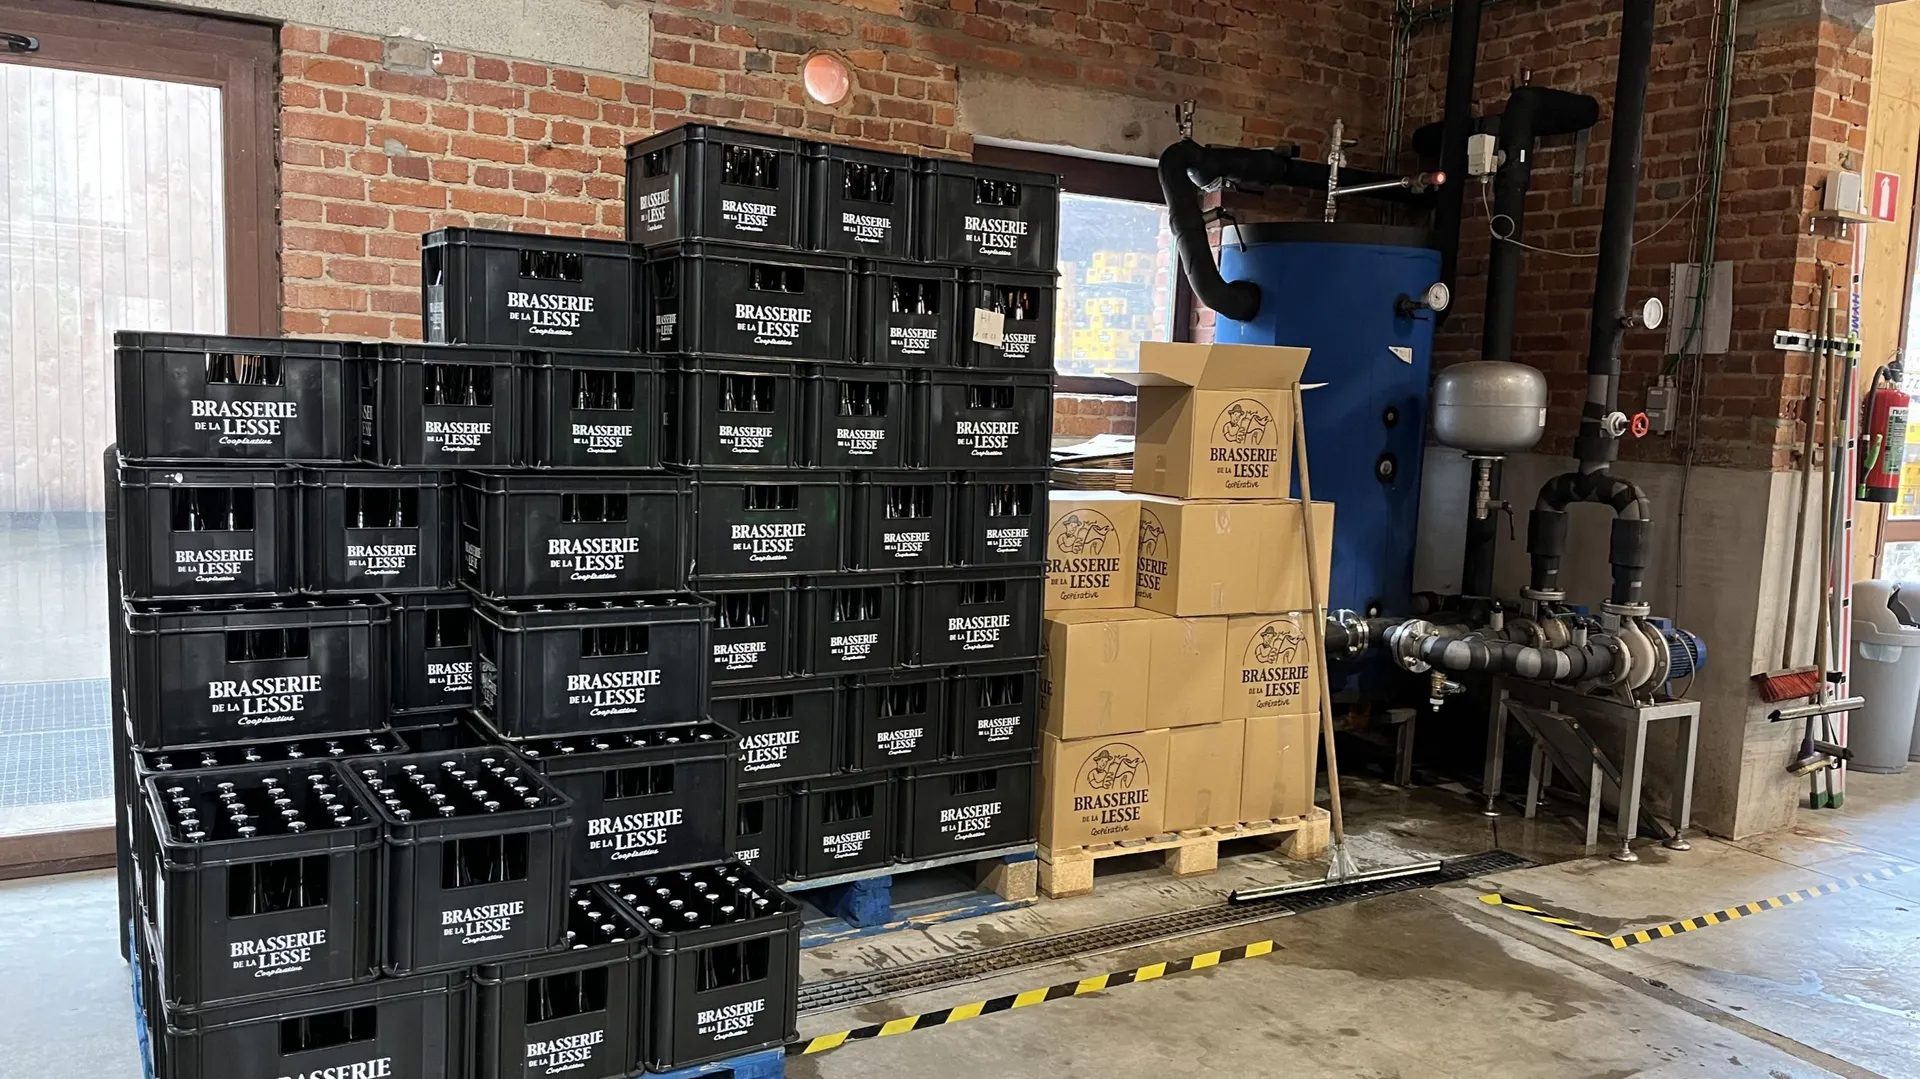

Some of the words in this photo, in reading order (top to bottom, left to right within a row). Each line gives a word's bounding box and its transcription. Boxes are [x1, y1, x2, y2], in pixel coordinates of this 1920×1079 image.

[722, 200, 776, 216] BRASSERIE
[738, 213, 768, 226] LESSE
[843, 213, 891, 228] BRASSERIE
[965, 216, 1027, 235] BRASSERIE
[856, 225, 884, 238] LESSE
[982, 233, 1017, 248] LESSE
[507, 292, 594, 312] BRASSERIE
[510, 312, 519, 320] DE
[533, 310, 580, 327] LESSE
[735, 304, 811, 323] BRASSERIE
[757, 321, 799, 338] LESSE
[890, 327, 937, 339] BRASSERIE
[904, 338, 929, 349] LESSE
[1002, 333, 1036, 343] ASSERIE
[1005, 343, 1030, 353] LESSE
[191, 400, 297, 418] BRASSERIE
[195, 422, 207, 430] DE
[209, 422, 221, 430] LA
[223, 419, 281, 435] LESSE
[425, 421, 491, 434] BRASSERIE
[572, 424, 632, 436] BRASSERIE
[719, 426, 772, 437] BRASSERIE
[837, 429, 885, 439] BRASSERIE
[956, 422, 1019, 434] BRASSERIE
[445, 434, 481, 445] LESSE
[590, 436, 623, 447] LESSE
[735, 437, 764, 447] LESSE
[851, 440, 877, 449] LESSE
[974, 436, 1008, 448] LESSE
[1210, 448, 1277, 462] BRASSERIE
[1234, 464, 1269, 478] LESSE
[731, 523, 806, 539] BRASSERIE
[884, 532, 930, 543] BRASSERIE
[986, 529, 1029, 538] BRASSERIE
[548, 538, 639, 555] BRASSERIE
[753, 538, 794, 553] LESSE
[897, 542, 923, 552] LESSE
[999, 538, 1022, 547] LESSE
[175, 549, 253, 563] BRASSERIE
[347, 545, 416, 557] BRASSERIE
[199, 562, 241, 575] LESSE
[368, 557, 406, 568] LESSE
[550, 560, 561, 568] DE
[575, 555, 624, 571] LESSE
[1045, 556, 1120, 575] BRASSERIE
[1070, 574, 1110, 588] LESSE
[1137, 572, 1161, 591] ESSE
[948, 615, 1010, 631] BRASSERIE
[830, 634, 878, 646] BRASSERIE
[966, 629, 1000, 643] LESSE
[714, 642, 766, 655] BRASSERIE
[844, 644, 870, 655] LESSE
[729, 653, 758, 664] LESSE
[427, 662, 472, 675] BRASSE
[1242, 666, 1309, 683] BRASSERIE
[446, 673, 472, 685] LESS
[567, 670, 661, 691] BRASSERIE
[209, 675, 321, 698] BRASSERIE
[1265, 681, 1300, 697] LESSE
[569, 696, 580, 704] DE
[582, 695, 592, 703] LA
[594, 688, 645, 707] LESSE
[212, 704, 225, 712] DE
[228, 703, 240, 711] LA
[243, 694, 304, 718] LESSE
[978, 716, 1020, 729] BRASSERIE
[877, 728, 923, 742] BRASSERIE
[990, 726, 1013, 736] LESSE
[890, 738, 916, 750] LESSE
[747, 746, 788, 764] LESSE
[1074, 789, 1148, 811] BRASSERIE
[940, 802, 1001, 822] BRASSERIE
[1101, 806, 1140, 824] LESSE
[588, 809, 682, 836] BRASSERIE
[958, 817, 991, 833] LESSE
[590, 840, 601, 849] DE
[602, 839, 613, 847] LA
[615, 828, 667, 854] LESSE
[823, 830, 870, 846] BRASSERIE
[836, 841, 863, 855] LESSE
[442, 901, 524, 925] BRASSERIE
[444, 928, 453, 936] DE
[465, 917, 511, 939] LESSE
[230, 930, 326, 957] BRASSERIE
[233, 961, 244, 969] DE
[246, 959, 257, 967] LA
[258, 948, 311, 972] LESSE
[697, 999, 765, 1025] BRASSERIE
[717, 1014, 754, 1036] LESSE
[527, 1030, 603, 1057] BRASSERIE
[549, 1047, 591, 1070] LESSE
